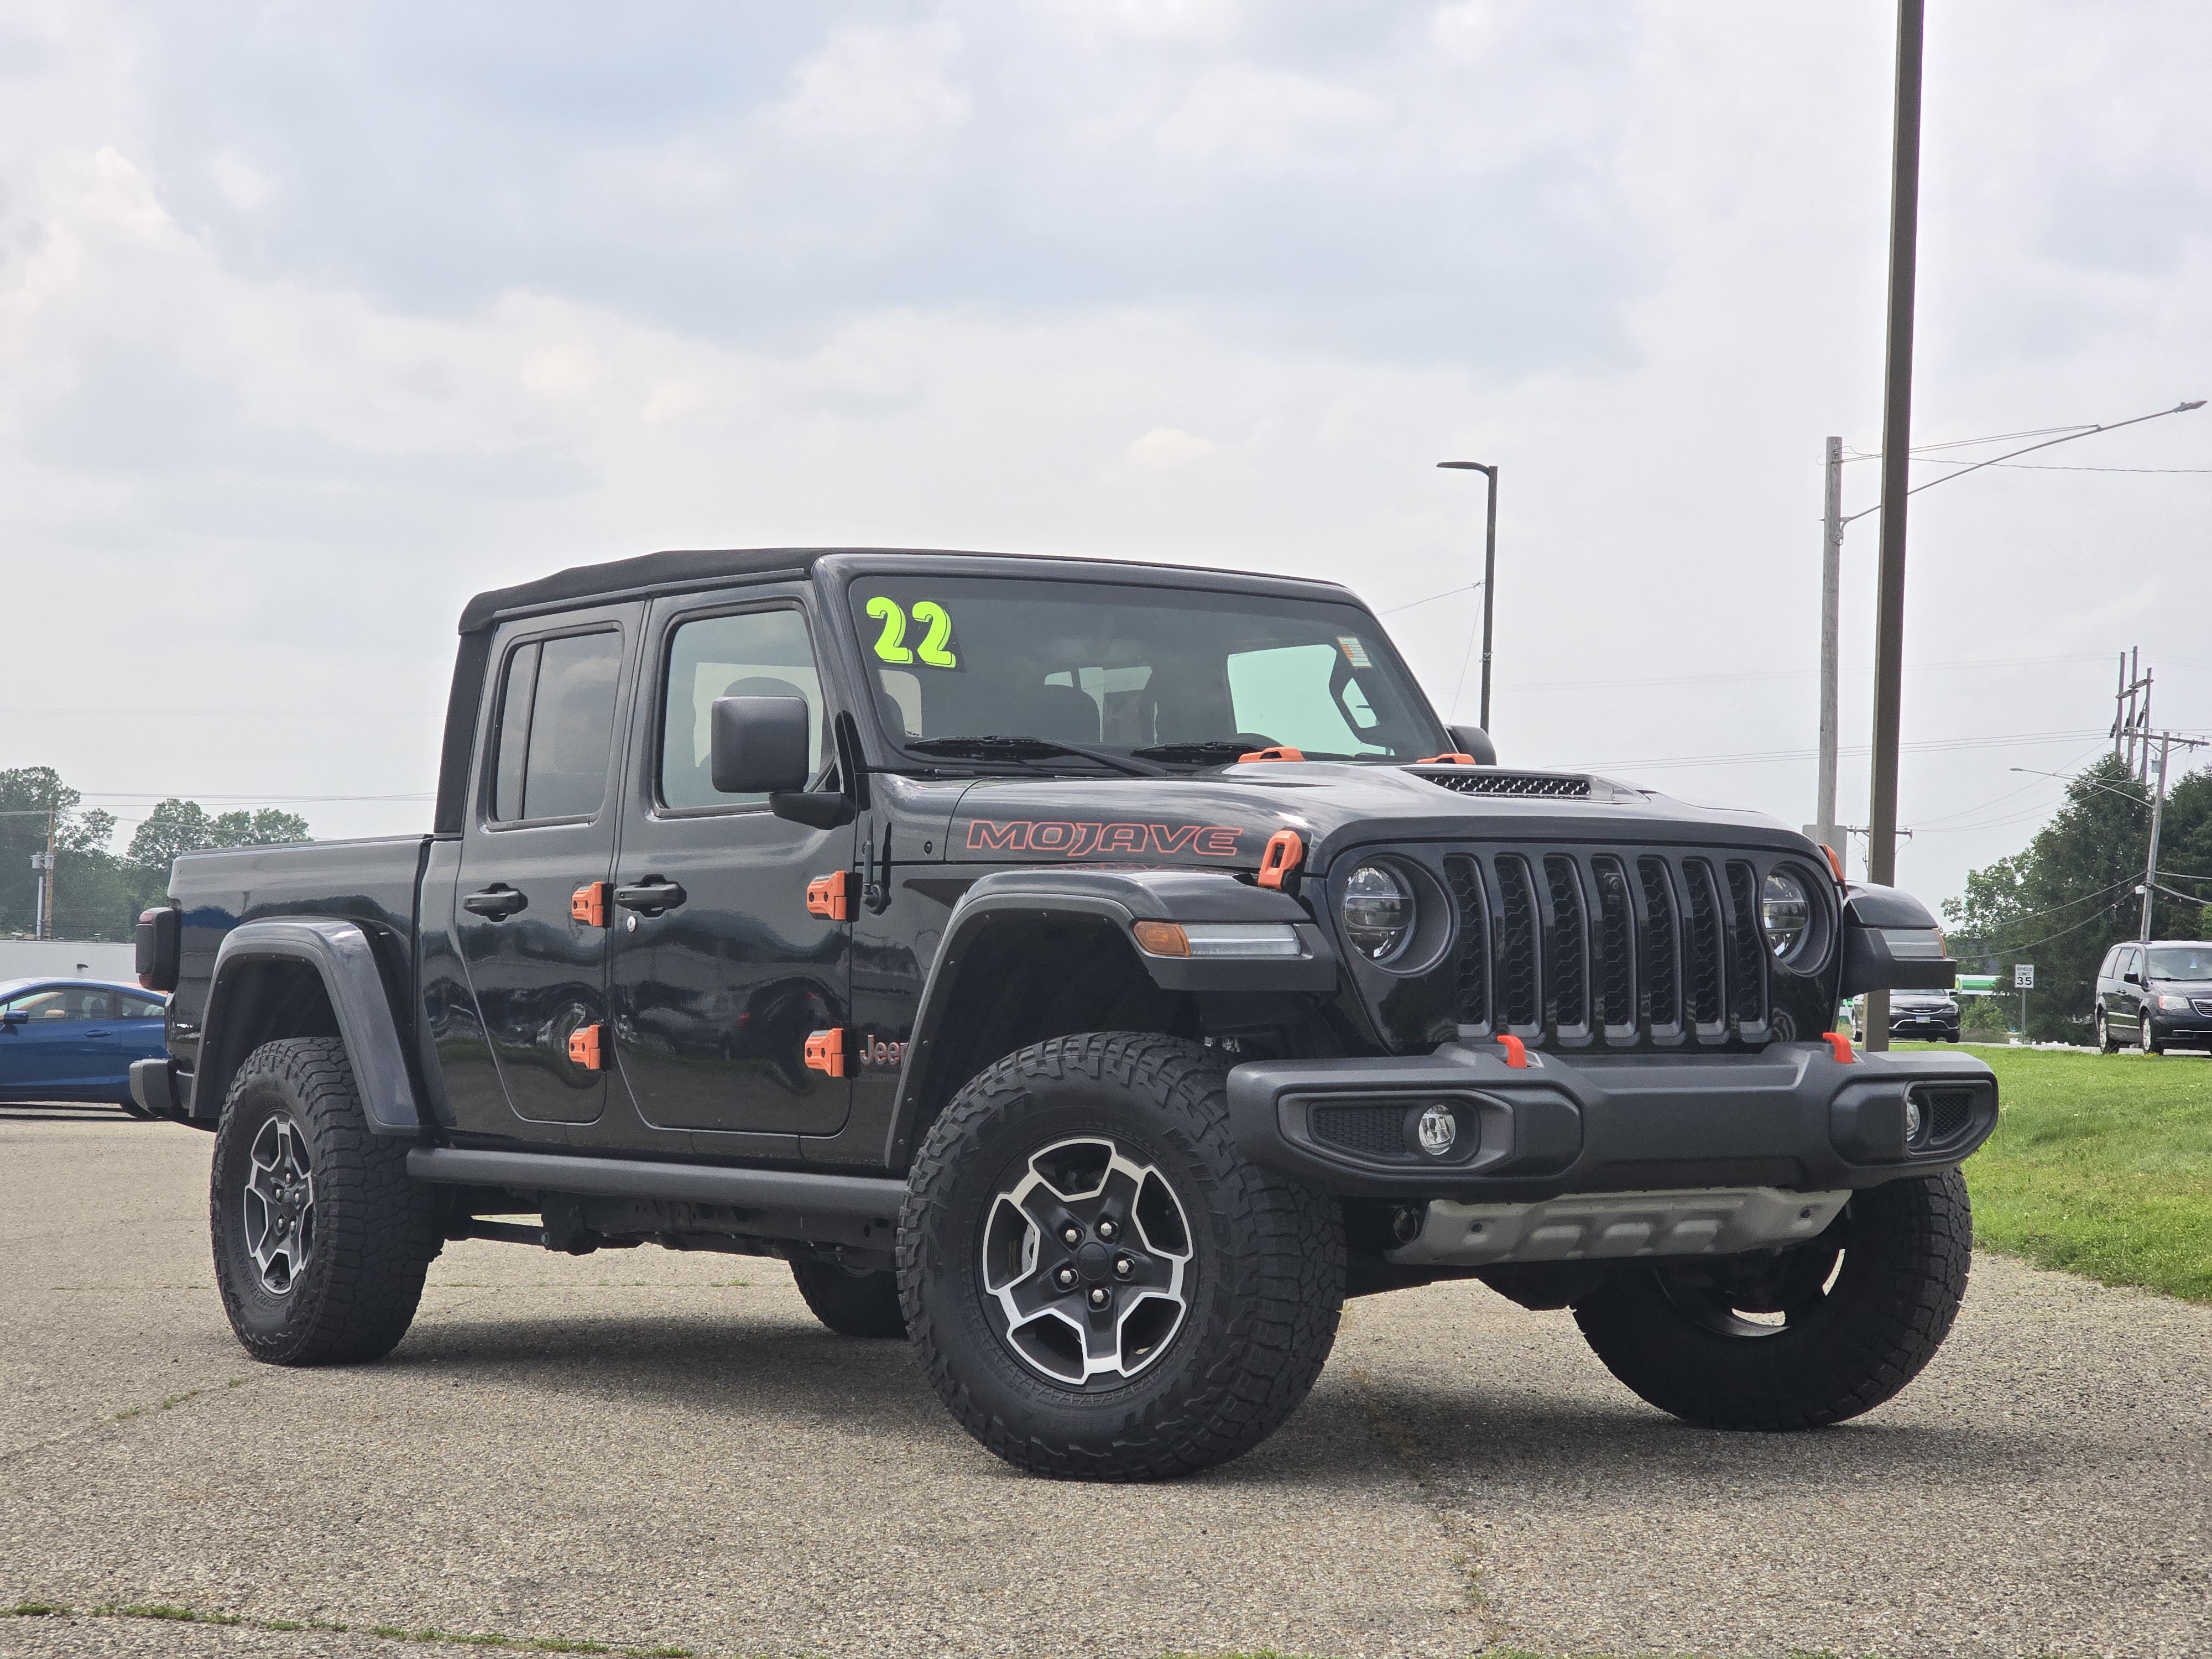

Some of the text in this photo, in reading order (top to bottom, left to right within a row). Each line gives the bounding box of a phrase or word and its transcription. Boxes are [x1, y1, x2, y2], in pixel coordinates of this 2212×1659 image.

[866, 597, 956, 668] 22
[967, 821, 1243, 856] MOJAVE
[2017, 977, 2032, 985] 35
